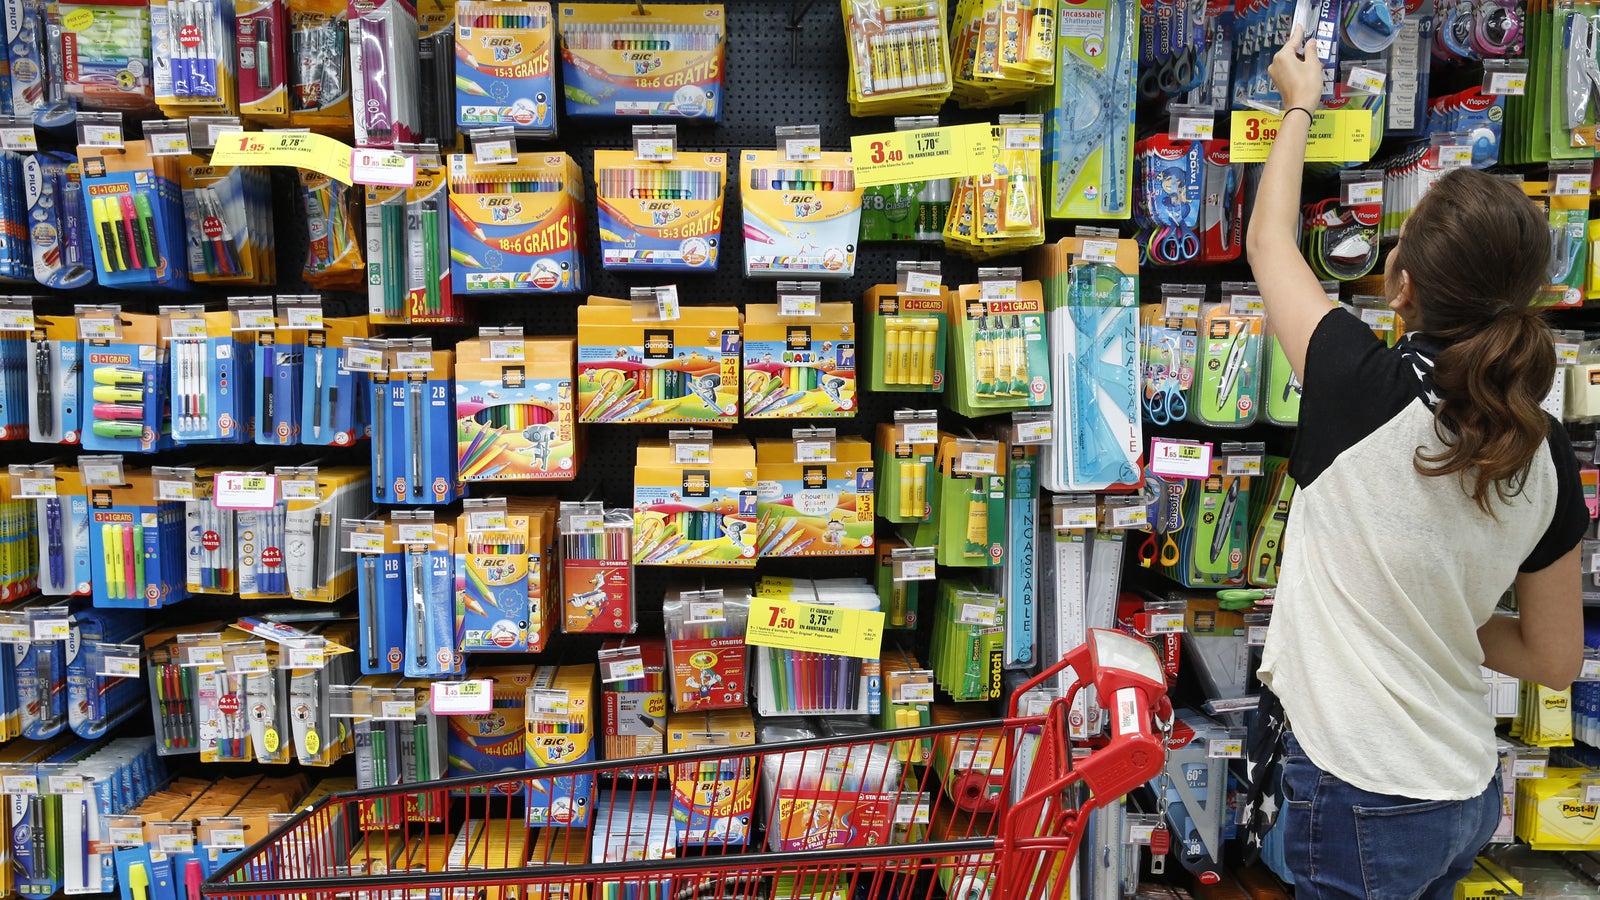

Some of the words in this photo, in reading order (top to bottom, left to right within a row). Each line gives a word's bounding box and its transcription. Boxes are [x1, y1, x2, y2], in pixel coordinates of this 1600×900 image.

[704, 9, 720, 17] 24
[1157, 7, 1173, 17] 3D
[9, 7, 17, 31] PILOT
[1161, 18, 1169, 54] sensoft
[1216, 25, 1224, 56] STOP
[494, 68, 513, 78] 15+3
[514, 50, 549, 78] GRATIS
[635, 77, 660, 88] 18+6
[663, 55, 719, 87] GRATIS
[1466, 98, 1490, 106] Maped
[1161, 148, 1183, 156] Maped
[546, 156, 561, 164] 24
[29, 174, 37, 198] PILOT
[657, 229, 679, 239] 15+3
[681, 206, 721, 238] GRATIS
[499, 238, 521, 251] 18+6
[524, 215, 568, 254] GRATIS
[993, 303, 999, 311] 2
[783, 351, 816, 363] MAXI
[721, 375, 738, 387] GRATIS
[432, 386, 446, 399] 2B
[559, 402, 571, 411] 20
[1168, 485, 1182, 494] 3D
[857, 513, 873, 522] GRATIS
[385, 559, 399, 571] HB
[433, 556, 447, 568] 2H
[990, 653, 1002, 698] Scotch
[649, 698, 663, 706] Prix
[648, 705, 664, 713] Choc
[720, 791, 752, 816] GRATIS
[1562, 803, 1595, 814] Post-it
